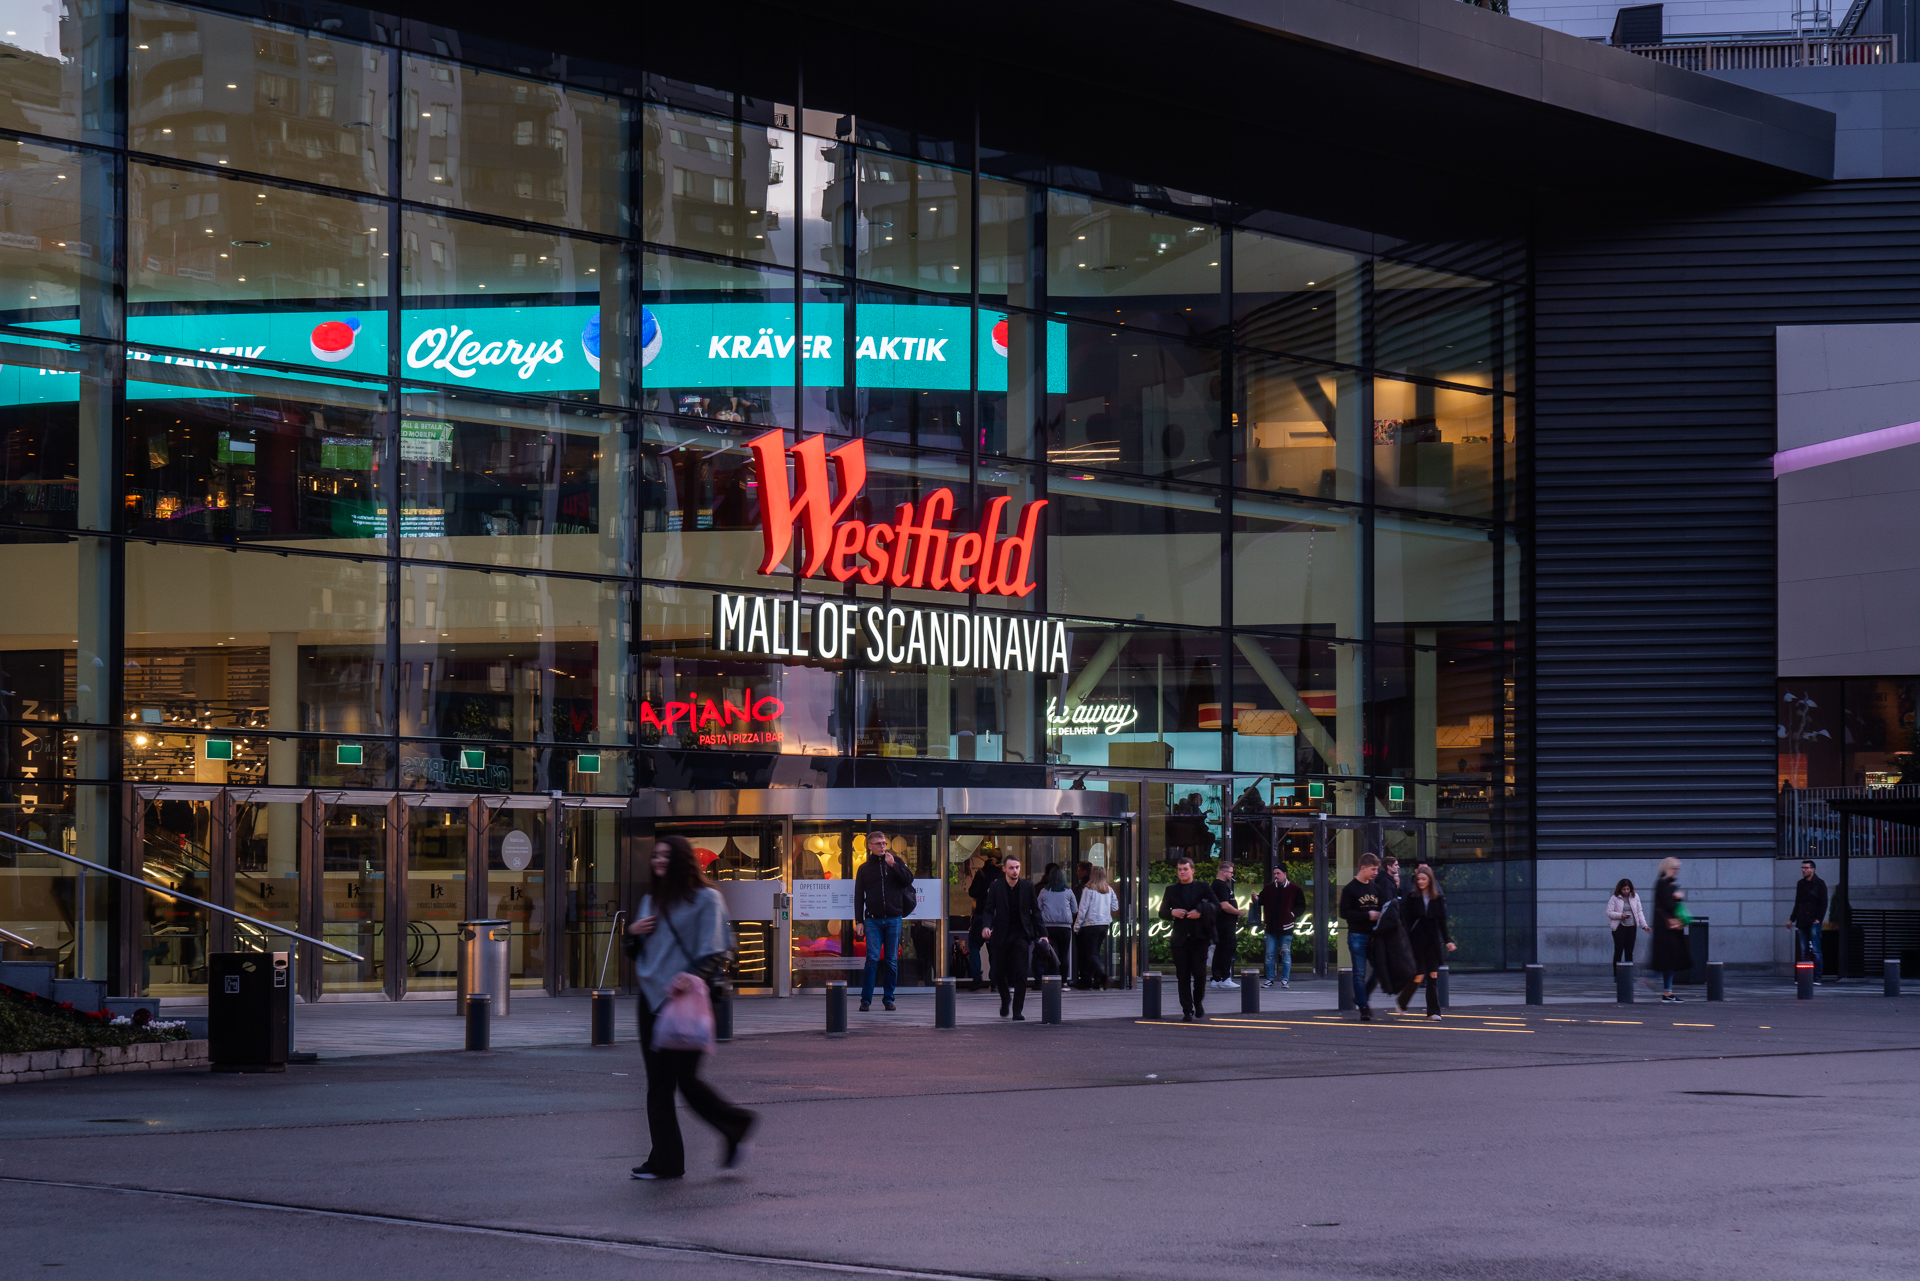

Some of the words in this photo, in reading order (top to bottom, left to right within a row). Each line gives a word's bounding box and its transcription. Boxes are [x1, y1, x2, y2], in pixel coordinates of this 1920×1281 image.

[407, 325, 563, 379] O'Learys
[708, 328, 832, 359] KRÄVER
[843, 336, 948, 361] AKTIK
[740, 428, 1048, 598] Westfield
[720, 593, 808, 656] MALL
[817, 602, 858, 659] OF
[867, 606, 1069, 673] SCANDINAVIA
[1059, 726, 1098, 736] DELIVERY
[1072, 704, 1138, 735] away
[699, 735, 728, 745] PASTA
[733, 733, 760, 744] PIZZA
[765, 732, 785, 743] BAR
[799, 882, 831, 891] ÖPPETTIDER
